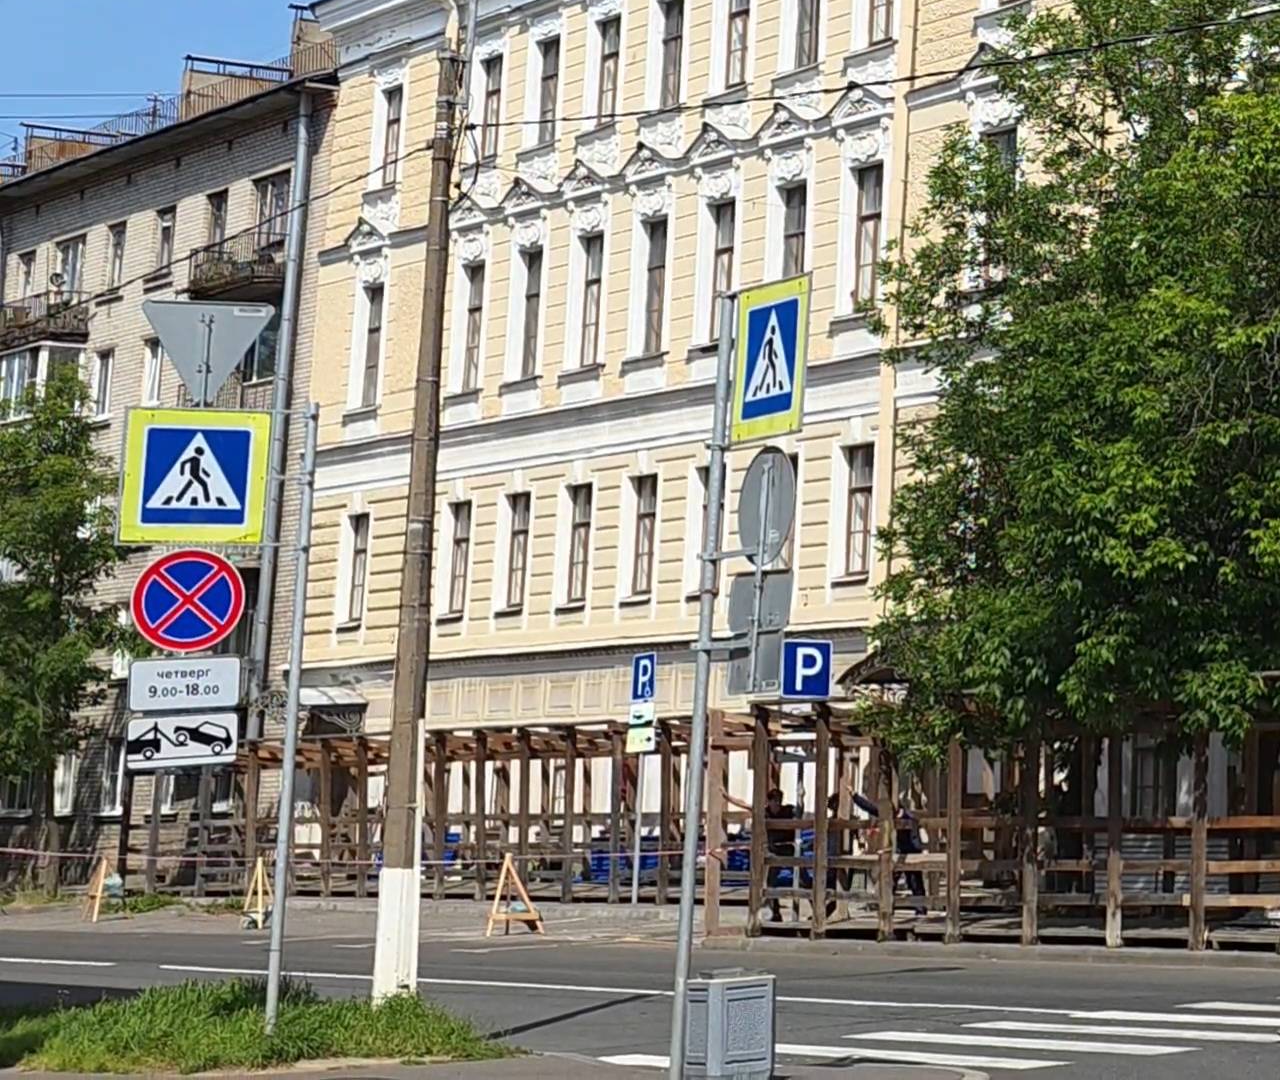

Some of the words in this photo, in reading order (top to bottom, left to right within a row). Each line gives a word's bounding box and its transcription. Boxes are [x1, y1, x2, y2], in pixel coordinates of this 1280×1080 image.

[157, 668, 211, 679] четверг
[796, 647, 823, 691] P
[148, 683, 220, 698] 9.00-18.00
